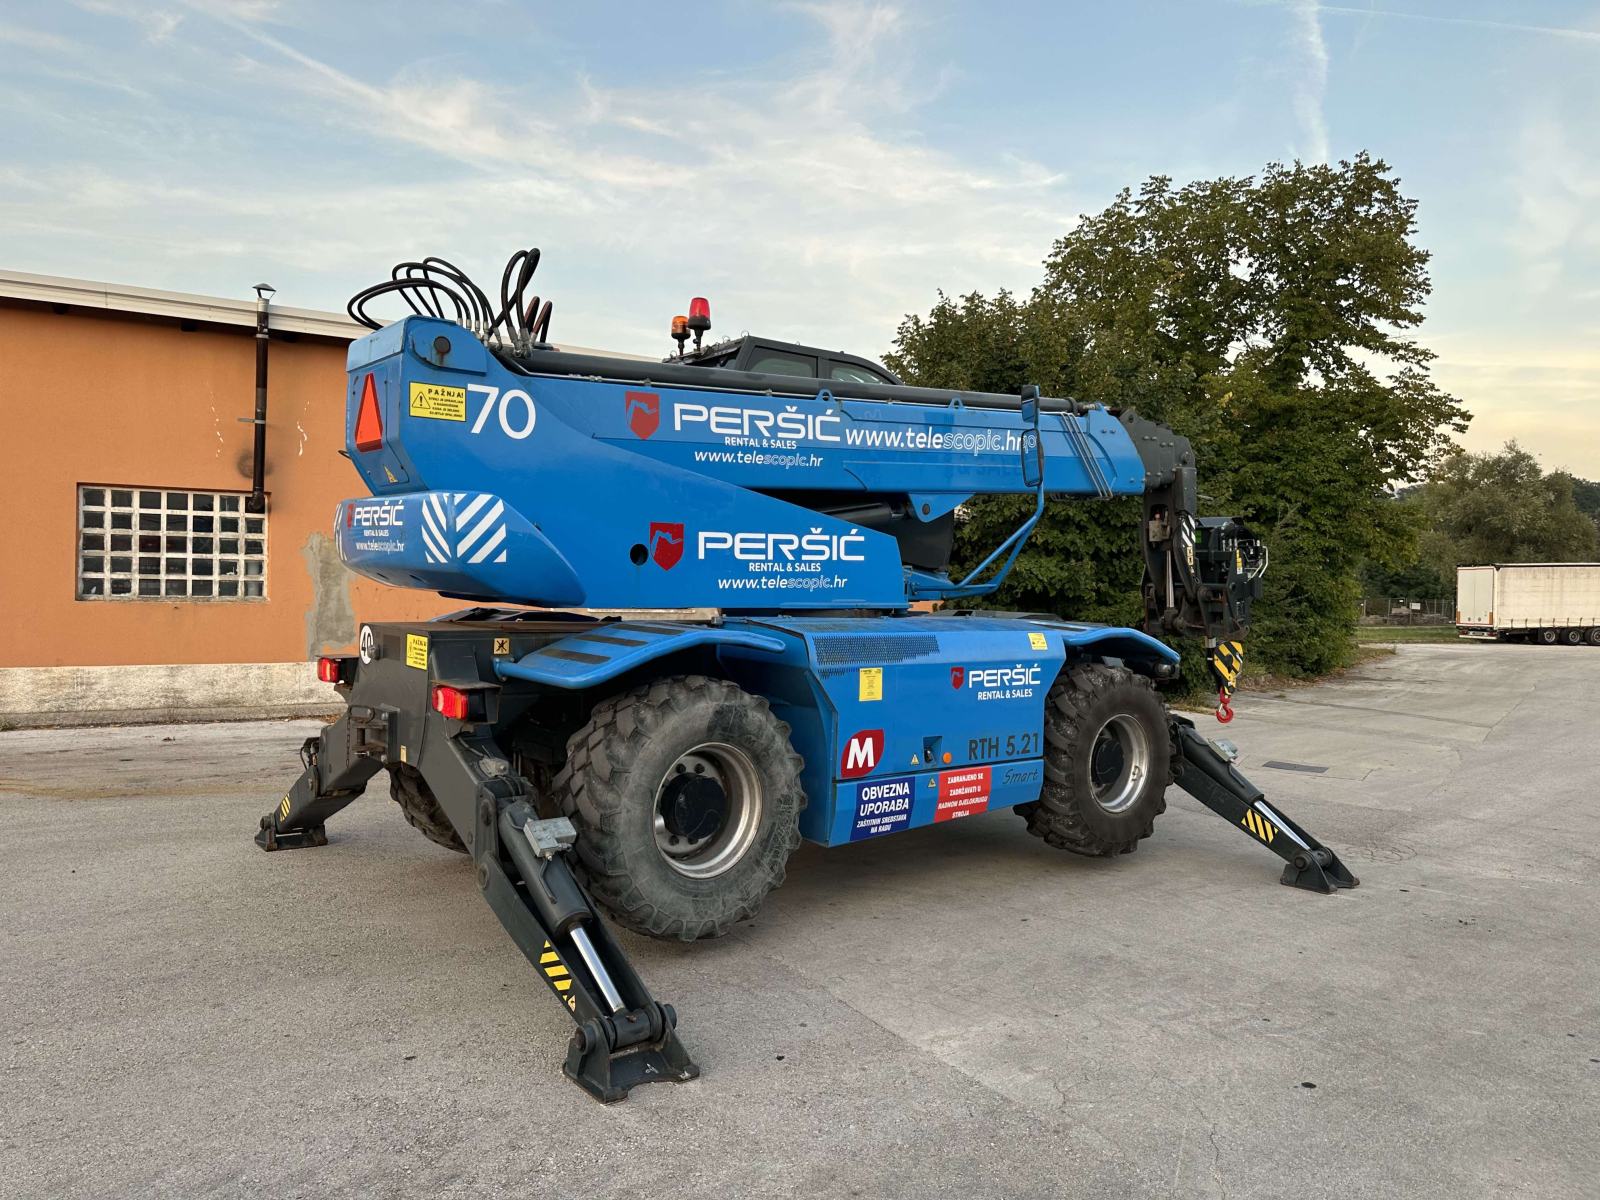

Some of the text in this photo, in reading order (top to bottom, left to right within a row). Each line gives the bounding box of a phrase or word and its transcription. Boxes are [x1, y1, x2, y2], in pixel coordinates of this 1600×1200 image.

[467, 383, 537, 440] 70
[673, 402, 841, 442] PERŠIĆ
[724, 436, 797, 450] RENTAL & SALES
[846, 426, 1022, 457] www.telescopic.hr
[694, 450, 824, 470] www.telescopic.hr
[353, 499, 405, 527] PERŠIĆ
[698, 527, 865, 561] PERŠIĆ
[749, 562, 821, 572] RENTAL & SALES
[718, 574, 848, 593] www.telescopic.hr
[968, 663, 1042, 689] PERŠIĆ
[977, 688, 1033, 701] RENTAL & SALES
[846, 737, 875, 770] M
[968, 732, 1039, 761] RTH 5.21
[1002, 768, 1039, 785] Smart
[861, 782, 910, 801] OBVEZNA
[860, 798, 909, 817] UPORABA
